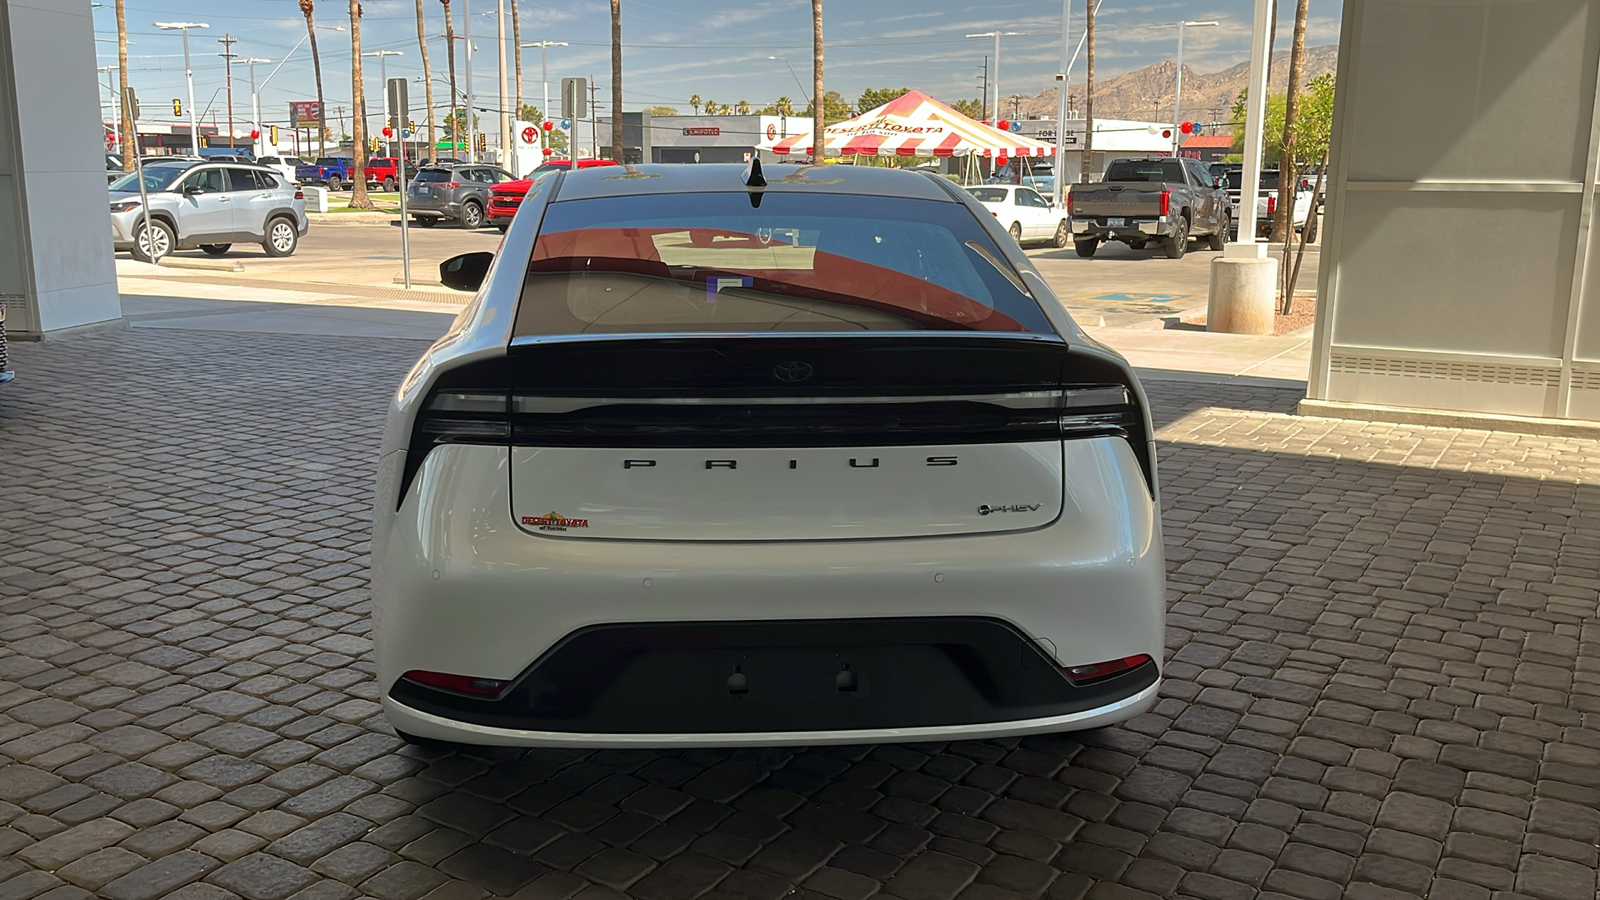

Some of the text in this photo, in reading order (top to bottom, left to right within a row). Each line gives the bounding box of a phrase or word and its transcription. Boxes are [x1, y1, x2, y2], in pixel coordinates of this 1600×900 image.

[882, 123, 943, 133] TOYOTA
[624, 456, 958, 469] PRIUS
[521, 516, 589, 527] DESERT TOYOTA
